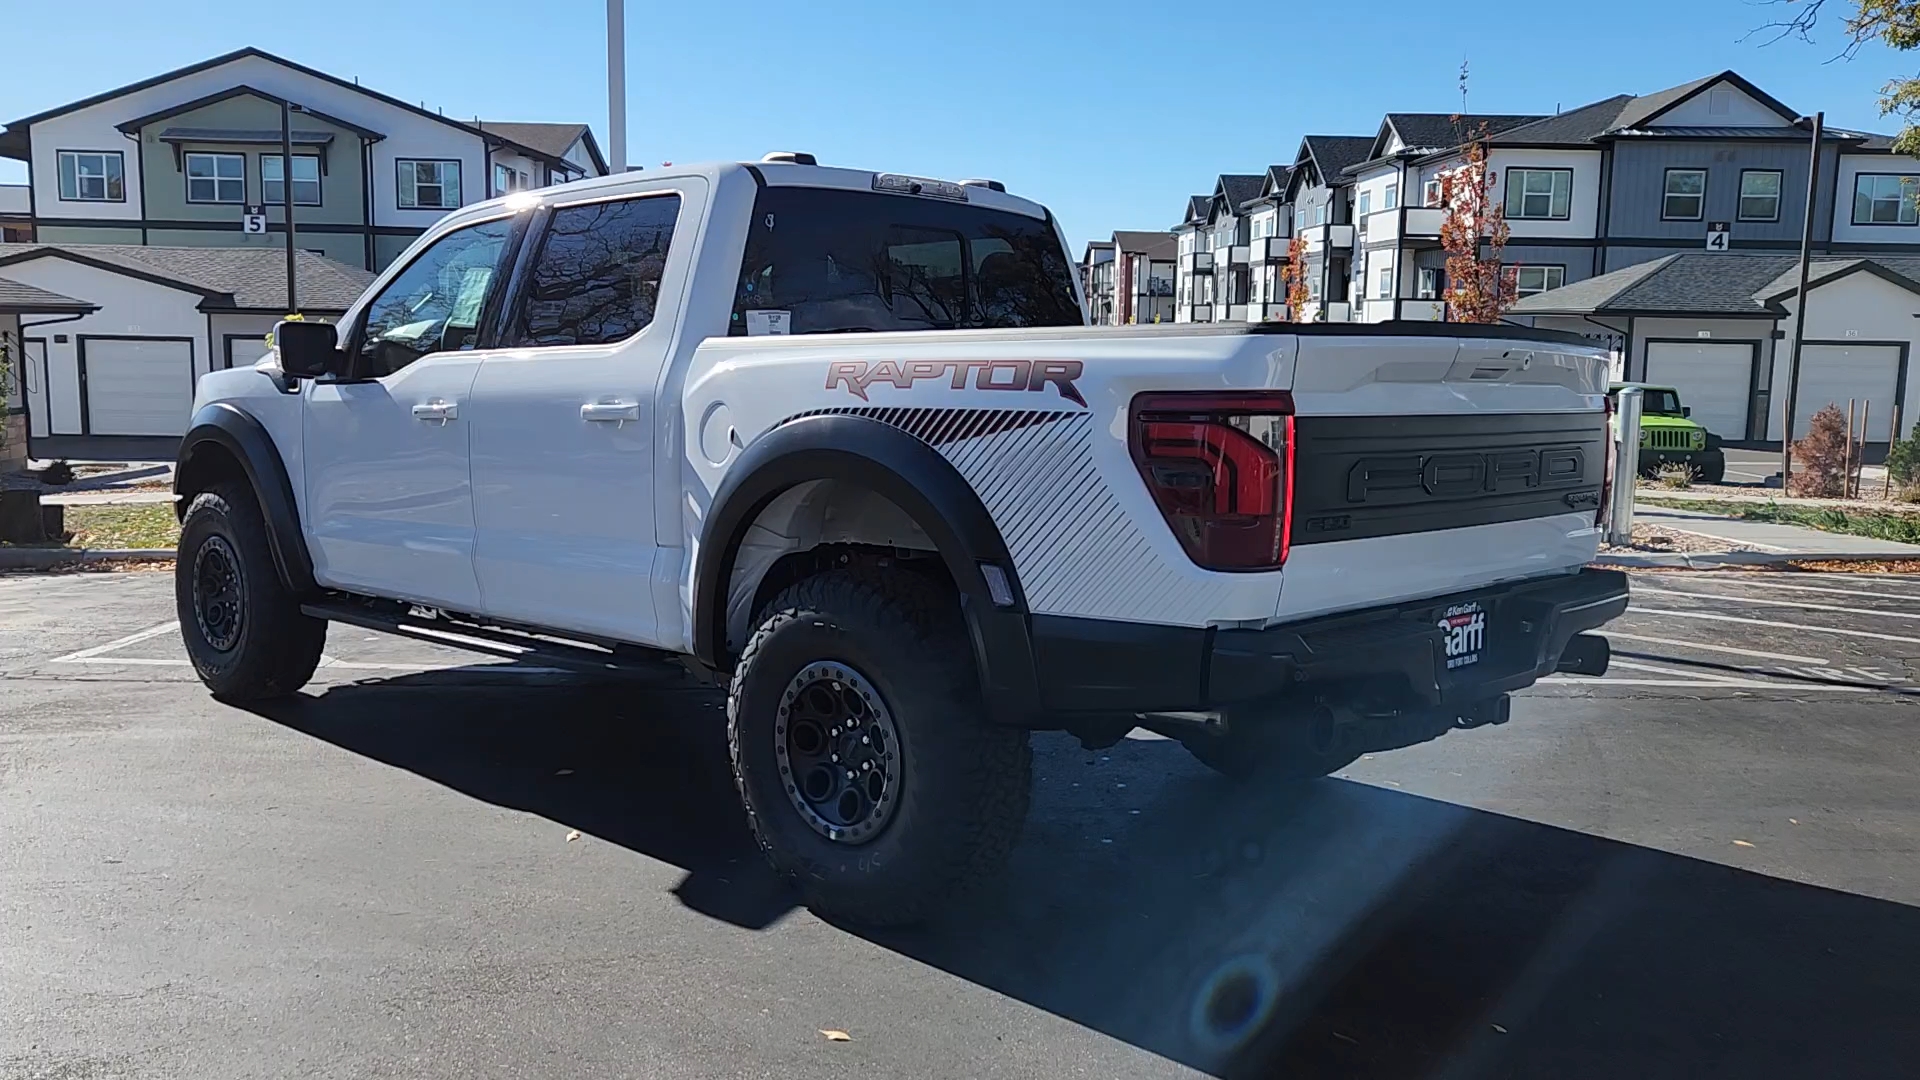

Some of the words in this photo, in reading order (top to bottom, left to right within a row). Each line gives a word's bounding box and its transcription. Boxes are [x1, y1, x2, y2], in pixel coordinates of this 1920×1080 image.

[249, 216, 261, 232] 5
[1710, 233, 1725, 250] 4
[825, 359, 1088, 409] RAPTOR
[1348, 447, 1584, 502] FORD
